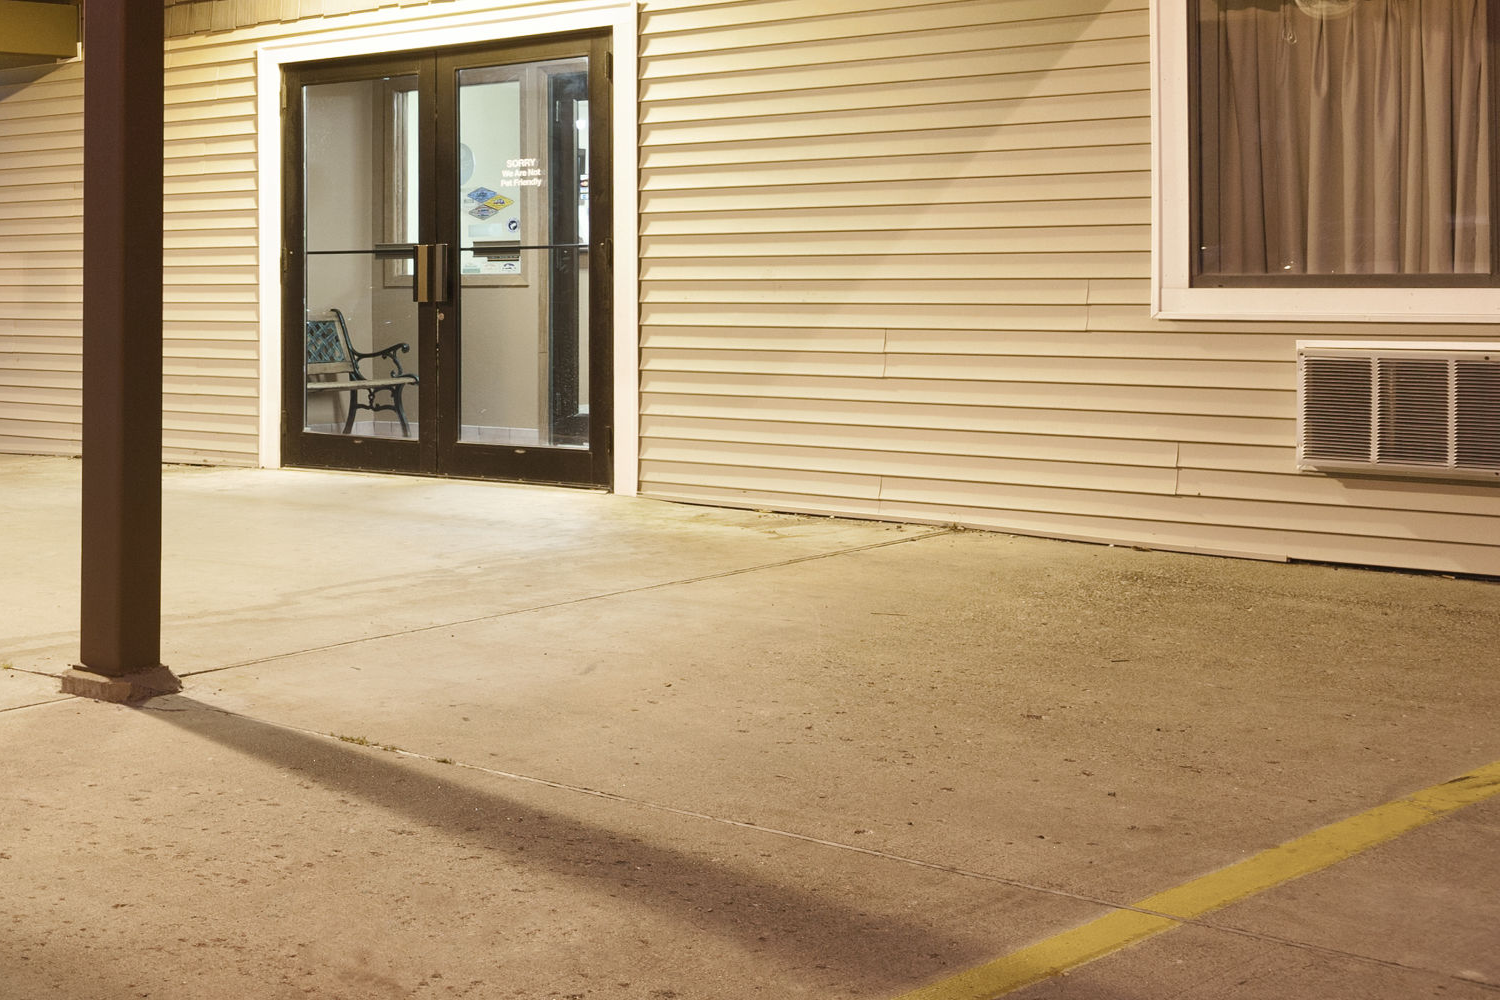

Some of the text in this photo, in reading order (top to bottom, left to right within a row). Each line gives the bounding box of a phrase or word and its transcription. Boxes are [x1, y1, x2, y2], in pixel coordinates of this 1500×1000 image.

[506, 158, 537, 168] SORRY
[501, 168, 541, 178] We Are Not
[513, 178, 542, 187] Friendly
